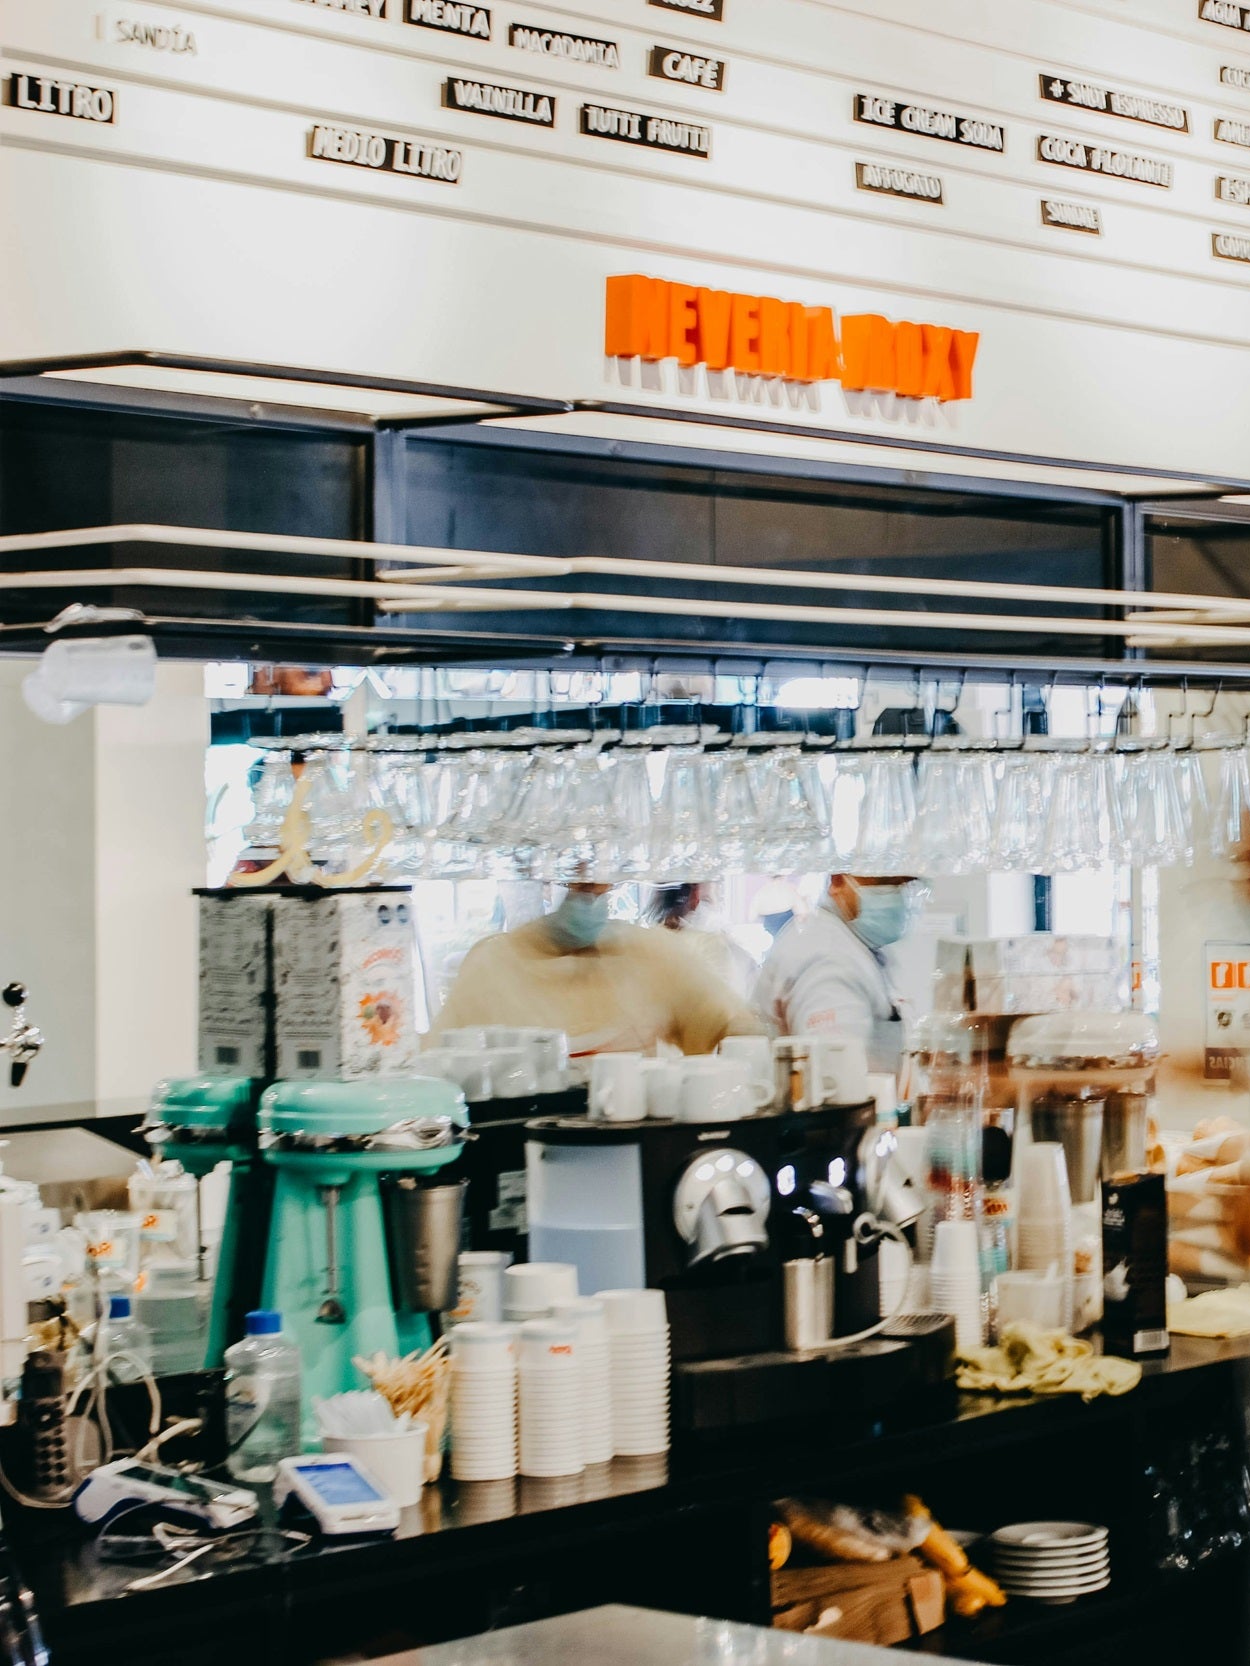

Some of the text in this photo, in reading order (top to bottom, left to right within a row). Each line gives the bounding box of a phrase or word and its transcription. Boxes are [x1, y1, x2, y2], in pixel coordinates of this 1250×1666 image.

[411, 0, 490, 38] MENTA
[17, 75, 113, 121] LITRO
[312, 127, 462, 181] MEDIO LITRO
